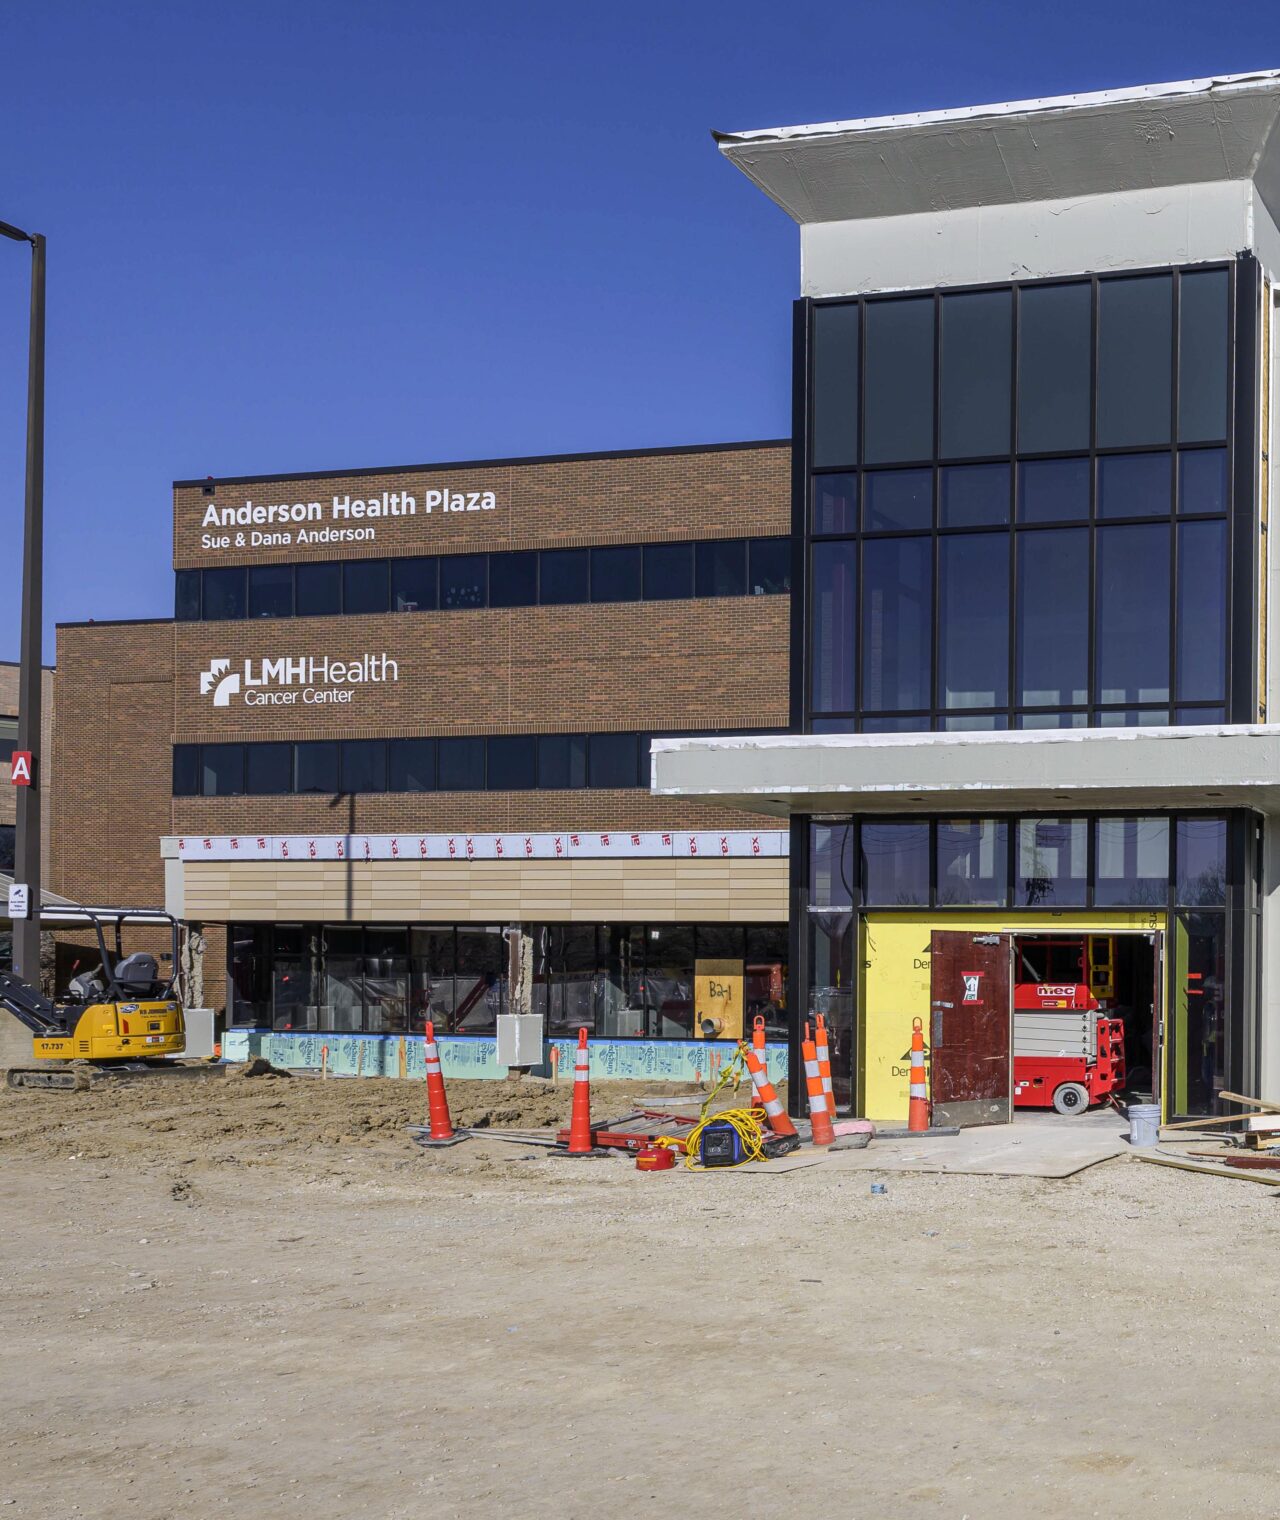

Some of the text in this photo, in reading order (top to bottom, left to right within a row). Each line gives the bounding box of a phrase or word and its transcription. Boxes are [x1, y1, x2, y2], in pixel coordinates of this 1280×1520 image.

[202, 488, 496, 527] Anderson Health Plaza
[201, 526, 375, 549] Sue & Dana Anderson
[244, 688, 355, 706] Cancer Center
[12, 756, 30, 780] A
[709, 980, 731, 1001] B2-1
[1038, 987, 1074, 995] mec
